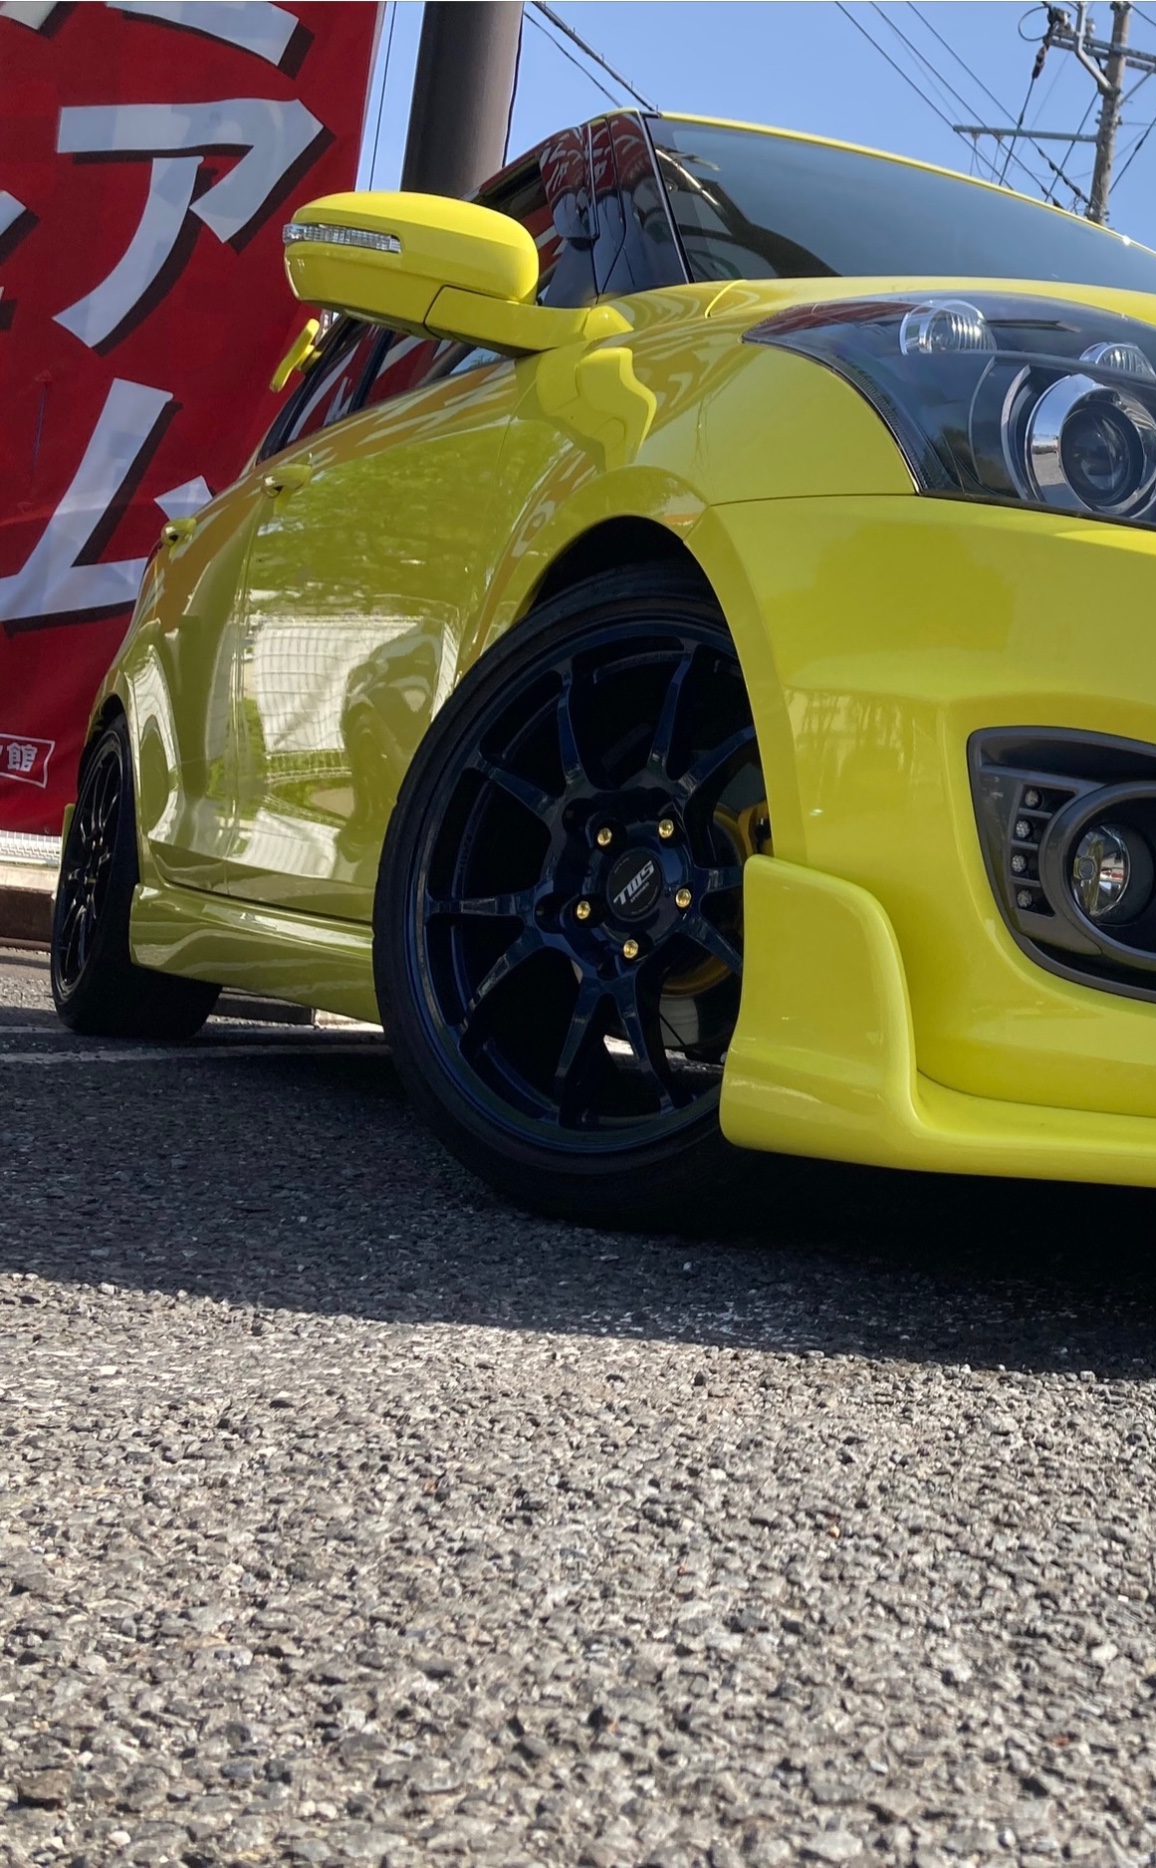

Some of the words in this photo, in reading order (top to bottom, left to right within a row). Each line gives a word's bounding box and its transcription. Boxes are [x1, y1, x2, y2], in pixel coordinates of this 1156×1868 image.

[0, 0, 324, 621] アム
[0, 742, 38, 773] 館
[612, 859, 655, 906] TWS
